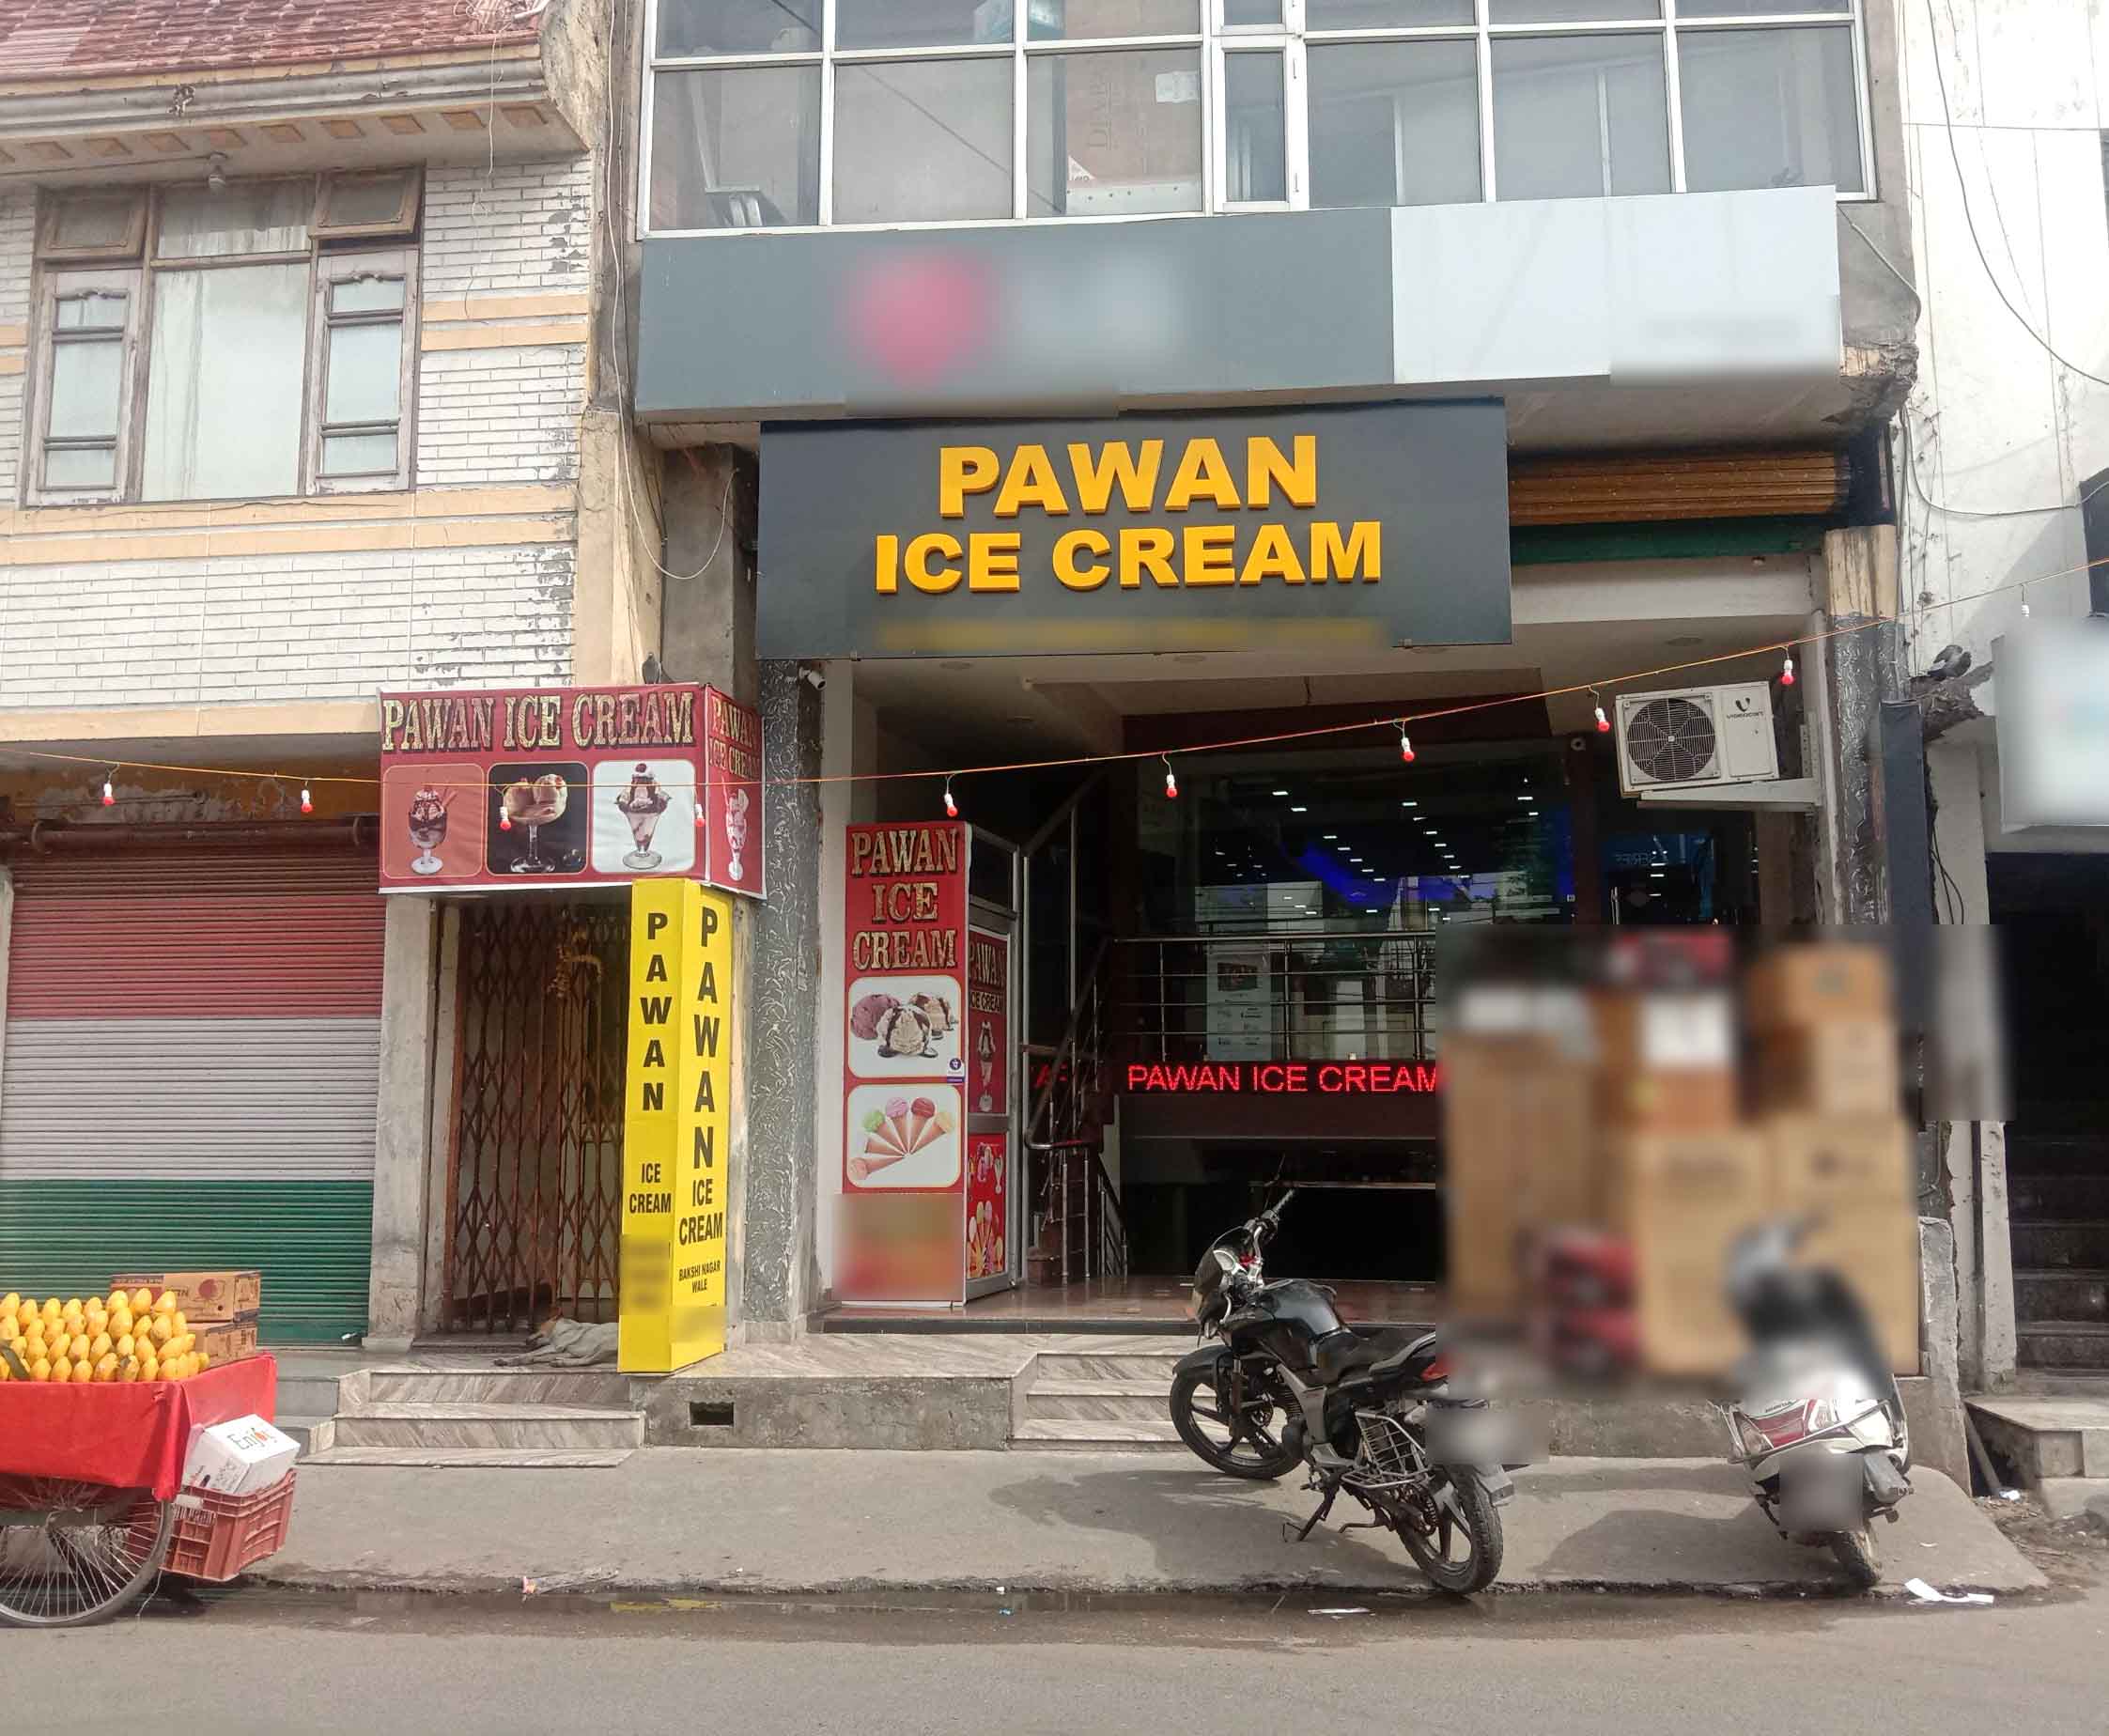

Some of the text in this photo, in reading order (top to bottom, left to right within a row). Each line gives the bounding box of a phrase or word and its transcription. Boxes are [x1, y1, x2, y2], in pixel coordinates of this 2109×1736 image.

[939, 435, 1317, 518] PAWAN
[875, 520, 1382, 594] ICE CREAM
[381, 691, 696, 751] PAWAN ICE CREAM
[851, 827, 957, 876] PAWAN
[872, 881, 938, 923] ICE
[852, 930, 957, 971] CREAM
[641, 912, 671, 1111] PAWAN
[694, 907, 720, 1170] PAWAN
[1128, 1064, 1240, 1092] PAWAN
[1253, 1065, 1309, 1093] ICE
[641, 1163, 661, 1184] ICE
[691, 1178, 713, 1206] ICE
[628, 1192, 672, 1214] CREAM
[678, 1217, 723, 1246] CREAM
[678, 1260, 721, 1281] BAKSHI NAGAR
[691, 1279, 707, 1293] WALE
